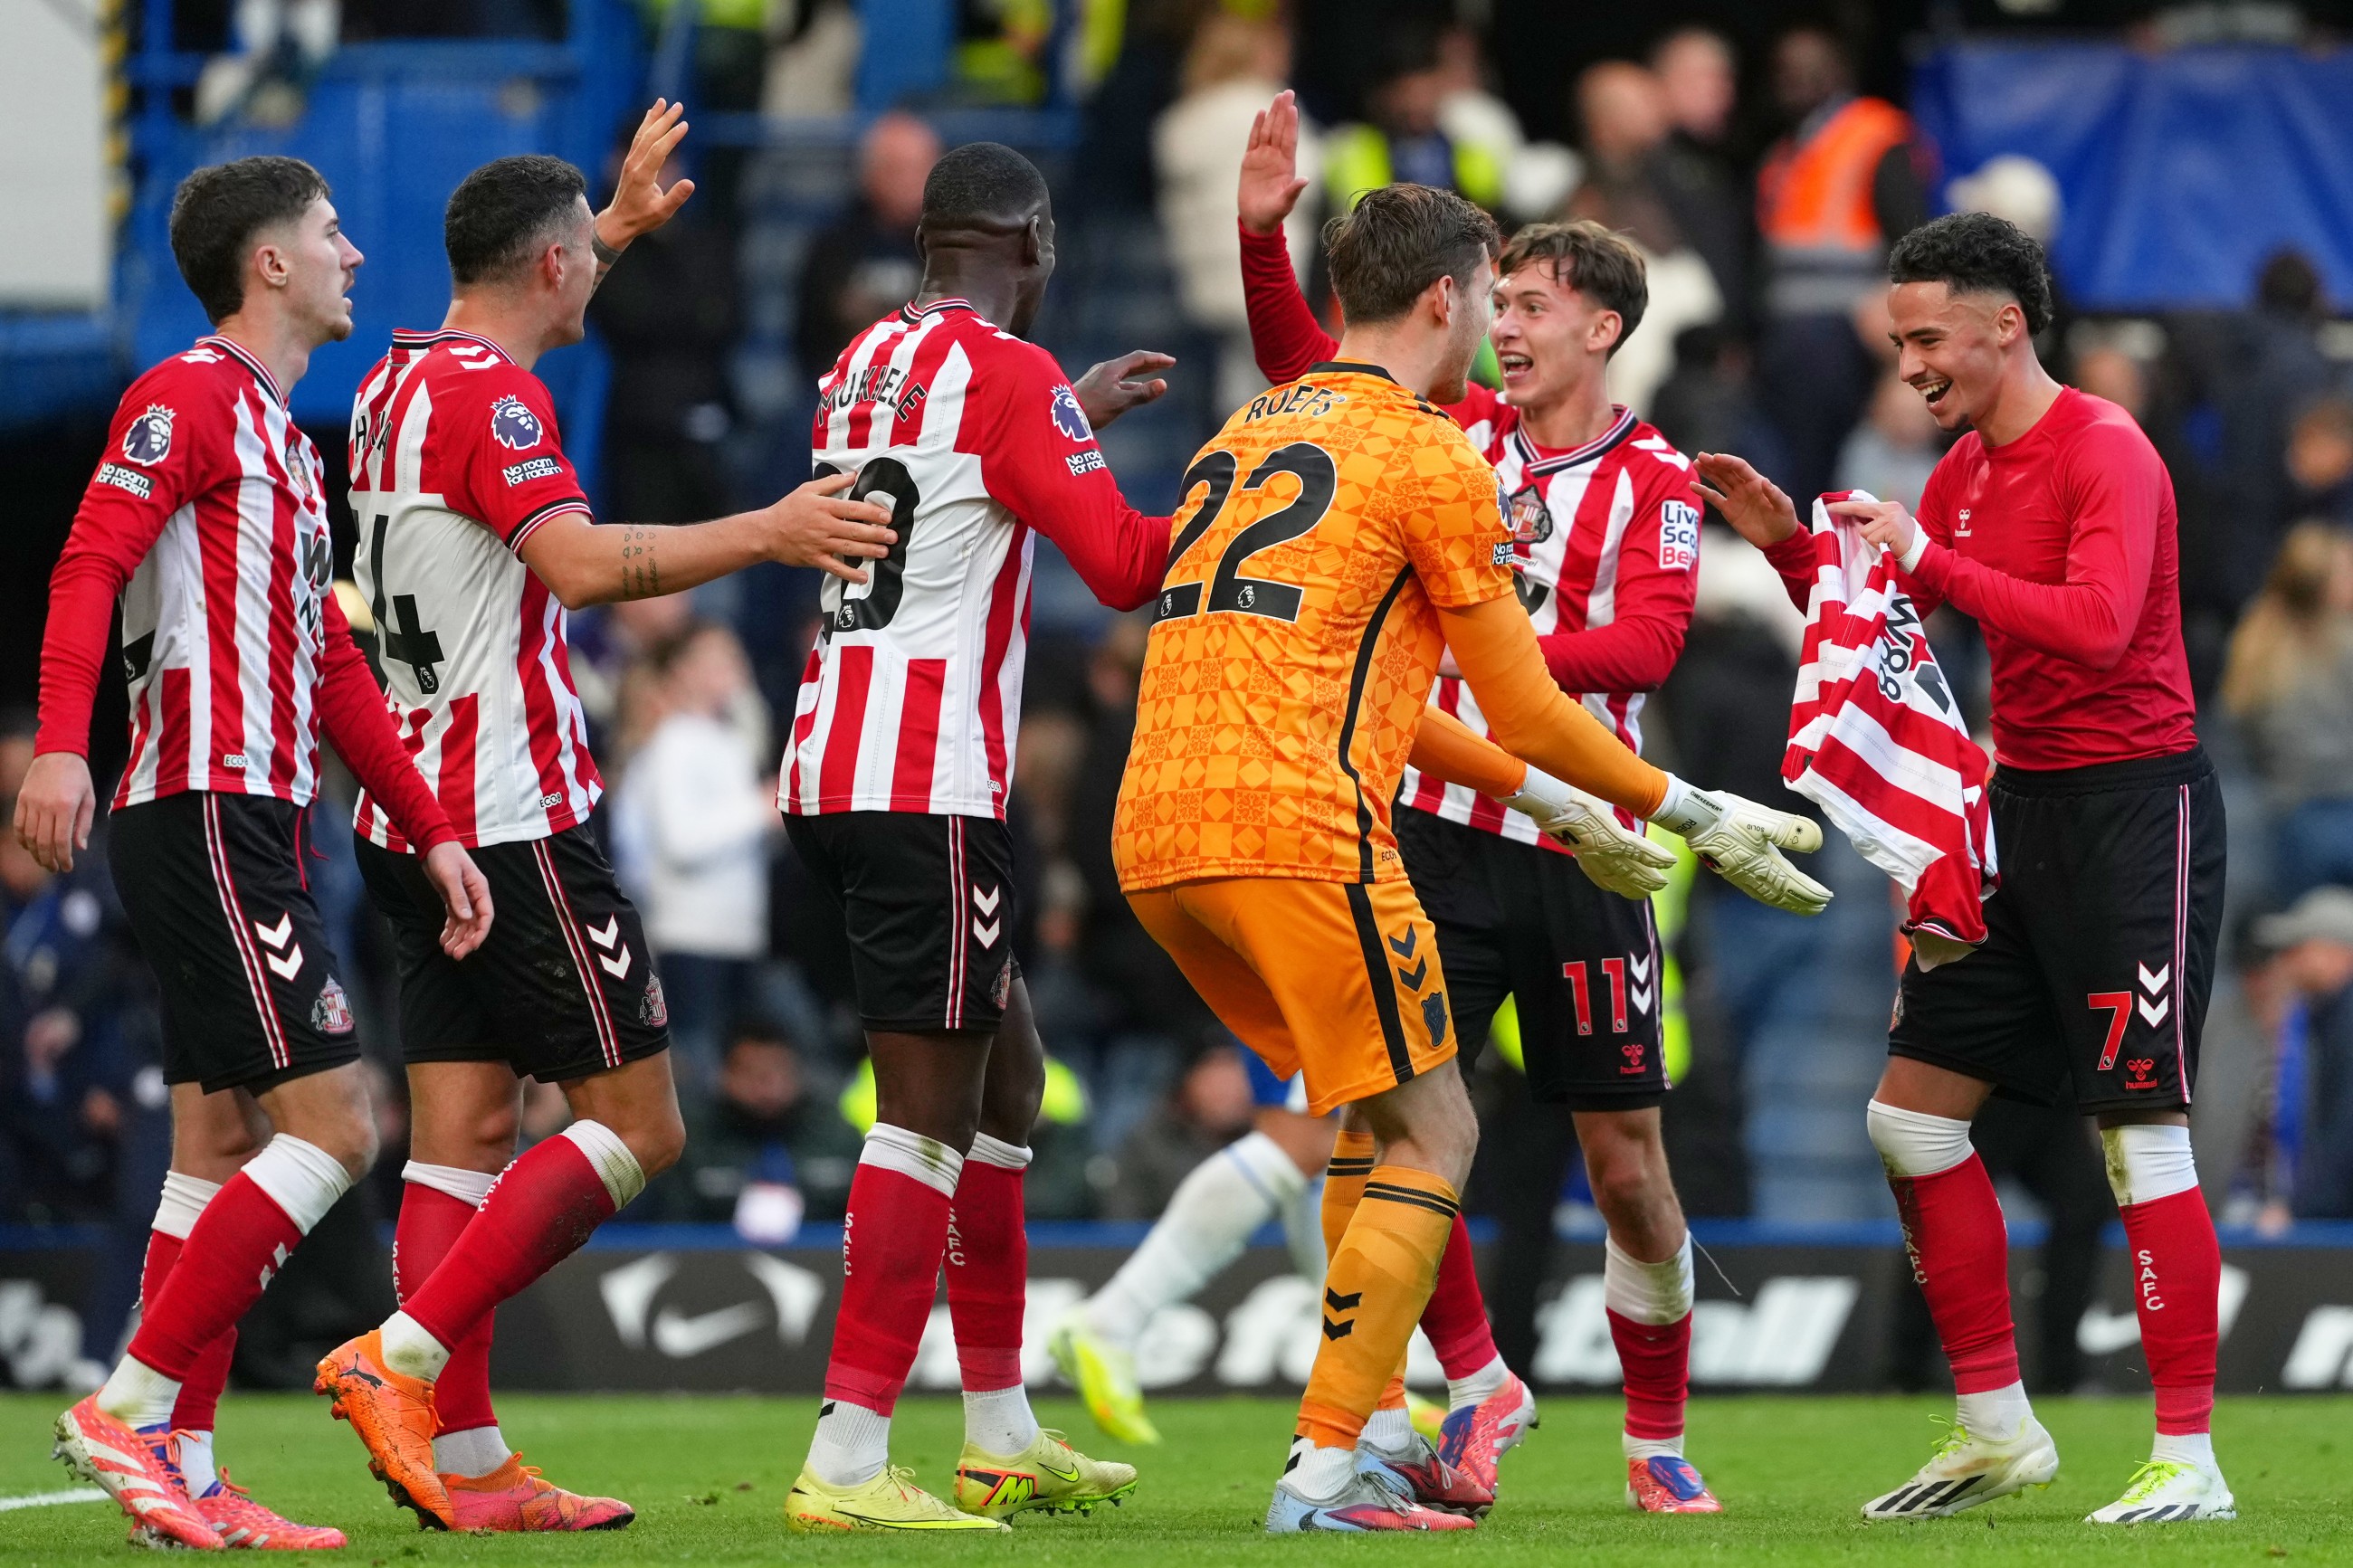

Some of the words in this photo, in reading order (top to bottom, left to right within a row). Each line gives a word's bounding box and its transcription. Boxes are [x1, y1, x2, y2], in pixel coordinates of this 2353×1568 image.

[818, 365, 928, 427] MUKIELE
[1244, 385, 1347, 424] ROEFS
[502, 466, 522, 478] No
[522, 458, 554, 472] room
[525, 465, 563, 480] racism
[1065, 454, 1084, 465] No
[1083, 451, 1102, 462] roo
[100, 462, 116, 476] No
[115, 467, 149, 489] room
[110, 476, 151, 500] racism
[1151, 441, 1338, 625] 22
[1494, 543, 1506, 556] No
[1663, 526, 1696, 549] Sco
[351, 508, 446, 696] 4
[538, 793, 561, 808] ECO8
[1747, 823, 1766, 832] SOLID
[1562, 956, 1629, 1036] 11
[2087, 990, 2133, 1071] 7
[2125, 1079, 2158, 1090] hummel
[478, 1159, 518, 1212] SAFC
[843, 1212, 854, 1277] SAFC
[947, 1206, 967, 1267] SAFC
[2138, 1250, 2166, 1311] SAFC
